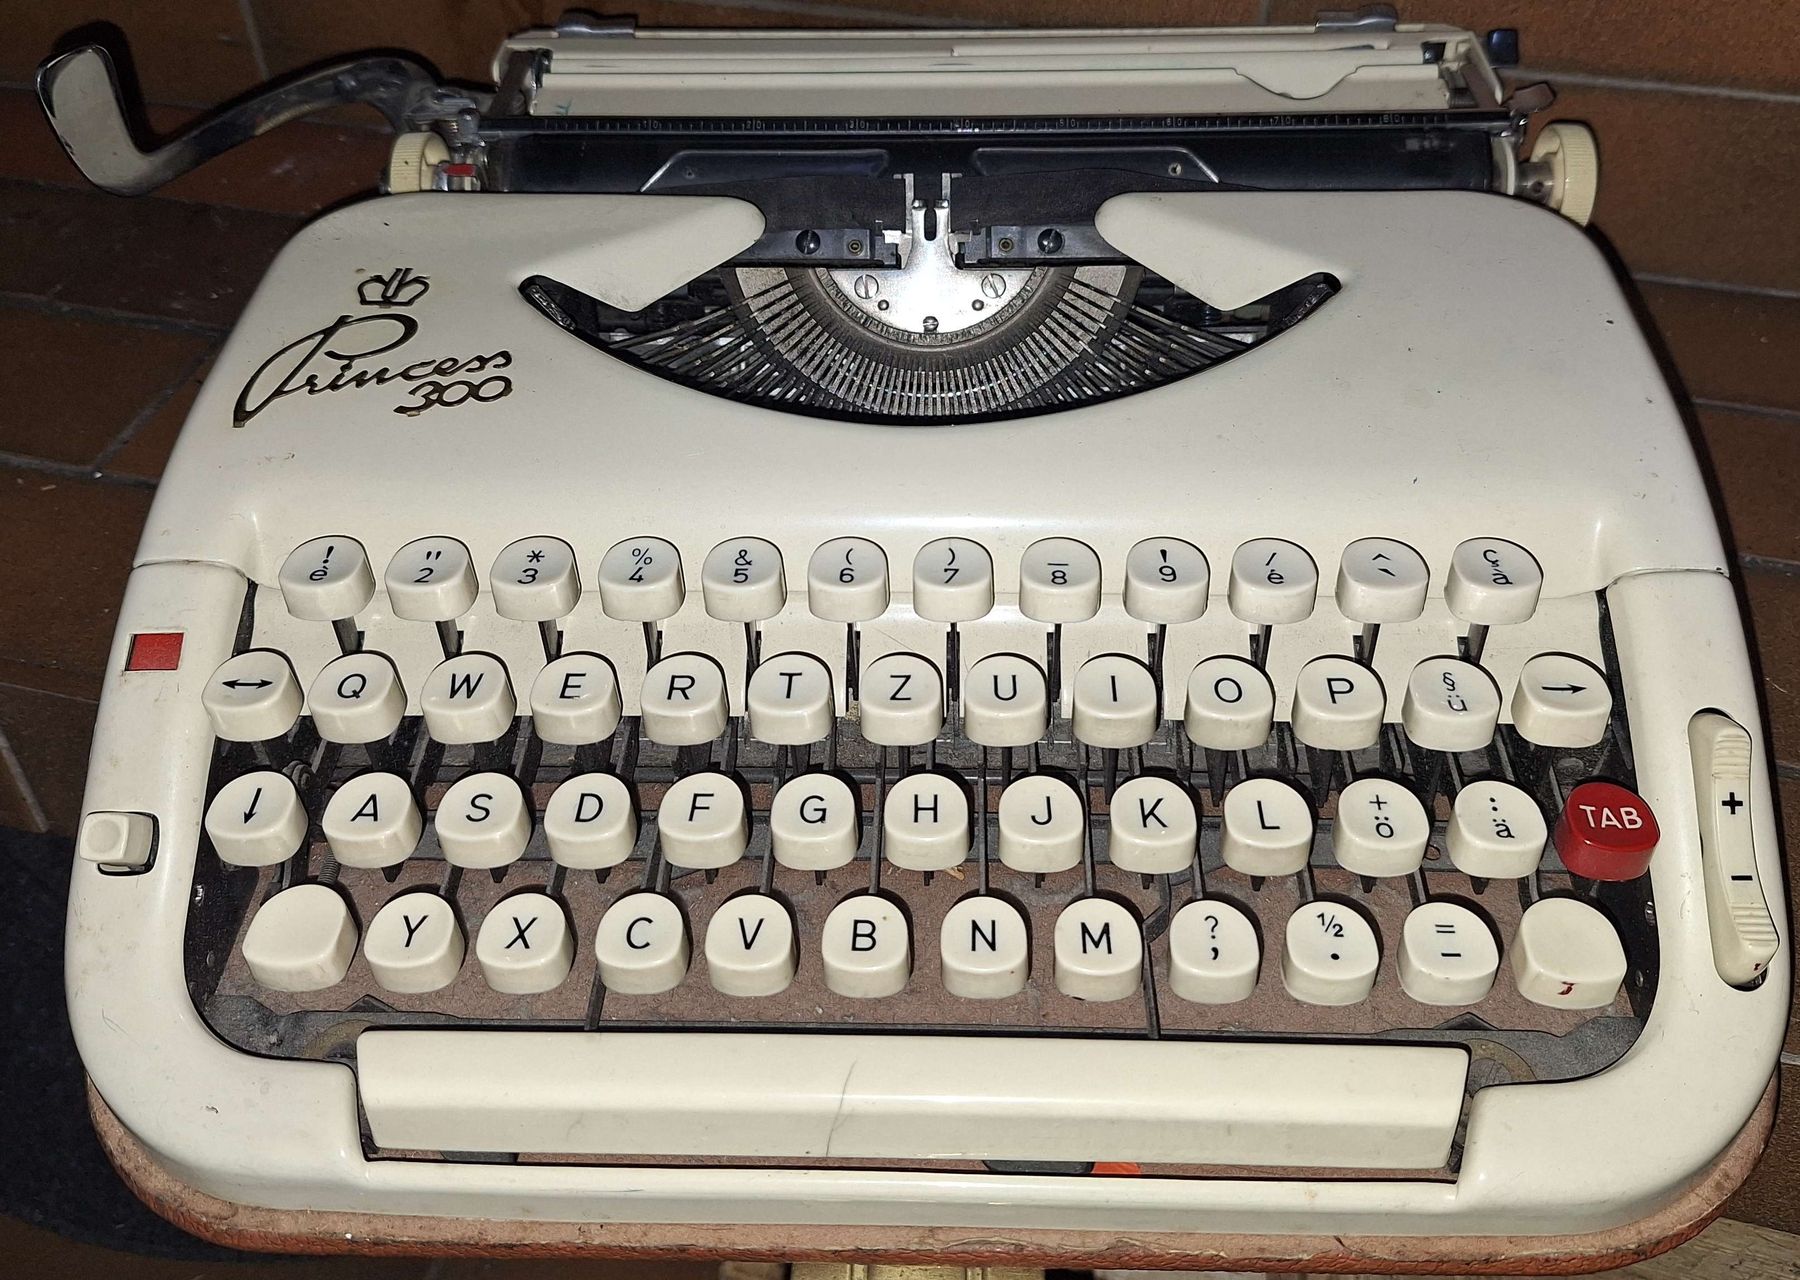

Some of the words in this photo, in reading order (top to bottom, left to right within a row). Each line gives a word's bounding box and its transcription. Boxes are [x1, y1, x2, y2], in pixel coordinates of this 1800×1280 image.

[232, 312, 512, 428] Princess
[393, 375, 513, 417] 300
[413, 568, 434, 583] 2
[517, 568, 538, 584] 3
[628, 567, 644, 582] 4
[733, 568, 748, 583] 5
[839, 568, 854, 583] 6
[944, 568, 959, 584] 7
[1051, 570, 1067, 585] 8
[1159, 566, 1177, 582] 9
[337, 674, 366, 699] Q
[449, 673, 484, 699] W
[560, 673, 586, 700] E
[667, 675, 695, 700] R
[779, 672, 802, 699] T
[890, 675, 911, 700] Z
[993, 675, 1017, 701] U
[1214, 678, 1242, 703] O
[1327, 678, 1354, 704] P
[1447, 695, 1468, 712] ü
[350, 794, 378, 822] A
[466, 794, 493, 822] S
[575, 793, 603, 822] D
[688, 793, 714, 821] F
[800, 795, 827, 823] G
[914, 794, 938, 823] H
[1031, 796, 1052, 825] J
[1139, 798, 1168, 828] K
[1257, 801, 1280, 829] L
[1579, 804, 1644, 831] TAB
[1375, 816, 1394, 838] ö
[1493, 819, 1515, 838] ä
[403, 915, 428, 947] Y
[505, 917, 537, 949] X
[626, 917, 653, 949] C
[739, 918, 764, 950] V
[851, 919, 876, 951] B
[971, 920, 996, 951] N
[1081, 922, 1112, 954] M
